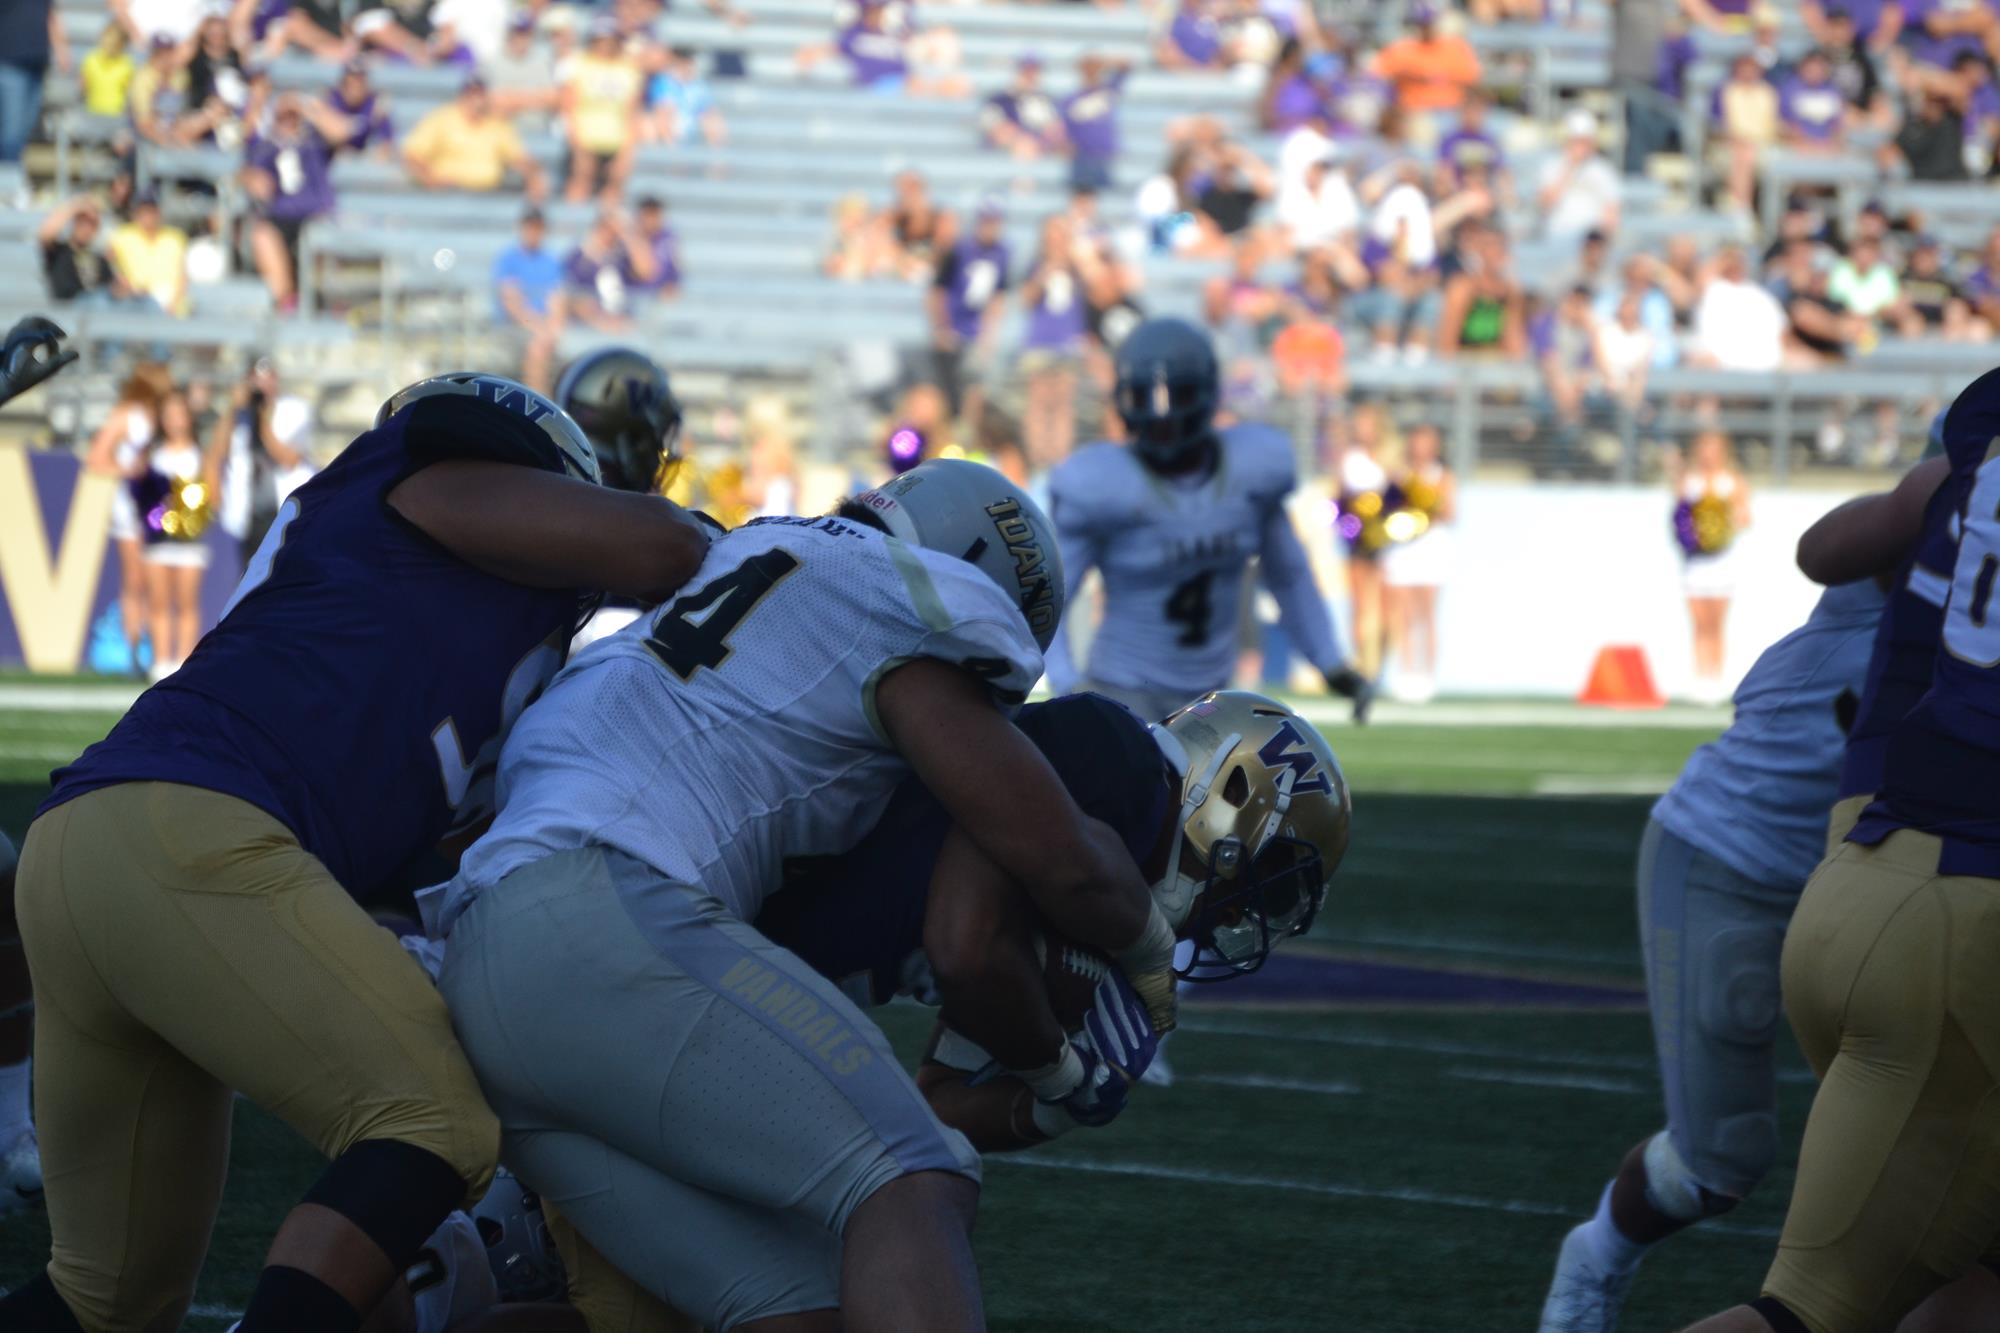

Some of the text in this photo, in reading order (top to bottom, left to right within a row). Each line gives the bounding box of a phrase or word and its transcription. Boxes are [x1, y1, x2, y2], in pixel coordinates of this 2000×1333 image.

[641, 545, 802, 684] 4
[984, 496, 1054, 634] IDAHO
[1165, 566, 1219, 647] 4
[1257, 718, 1334, 797] W
[718, 957, 875, 1078] VANDALS
